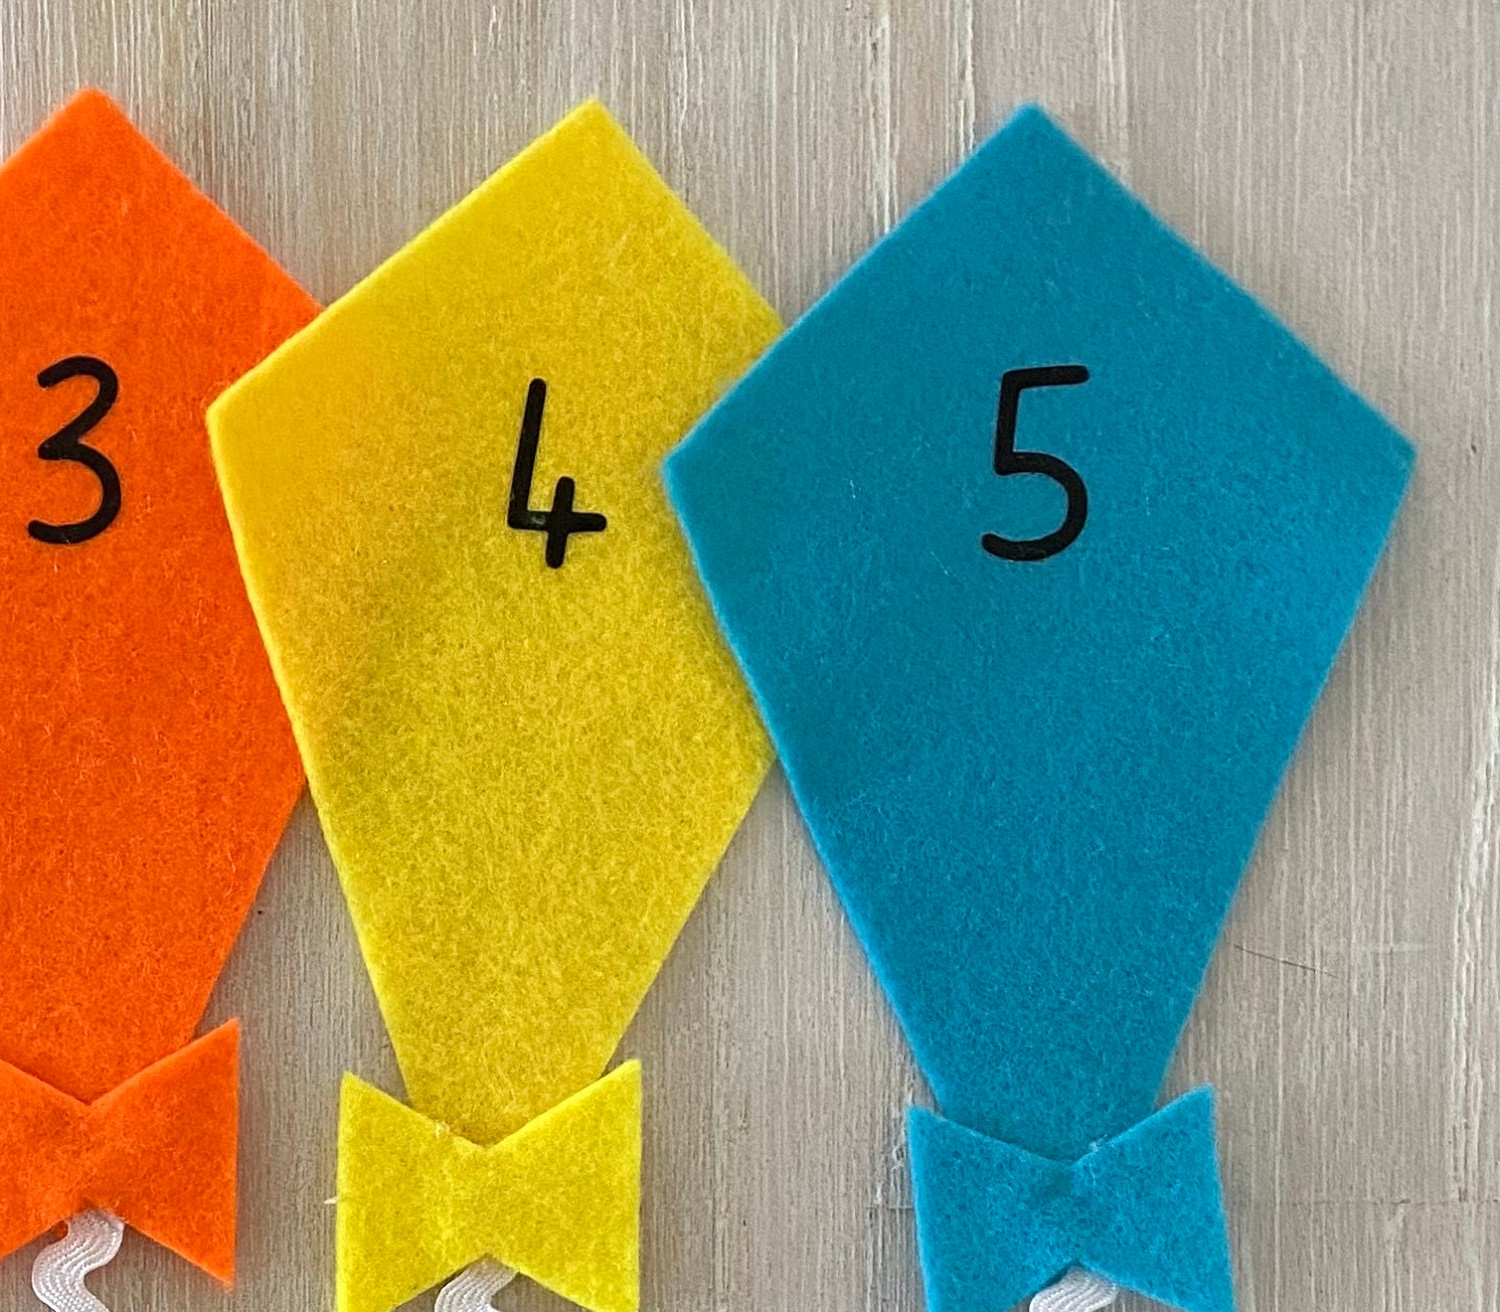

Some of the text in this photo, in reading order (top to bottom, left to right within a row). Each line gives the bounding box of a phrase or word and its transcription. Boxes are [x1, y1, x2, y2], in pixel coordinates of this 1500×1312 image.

[27, 356, 122, 545] 3
[507, 378, 607, 570] 4
[981, 364, 1090, 562] 5
